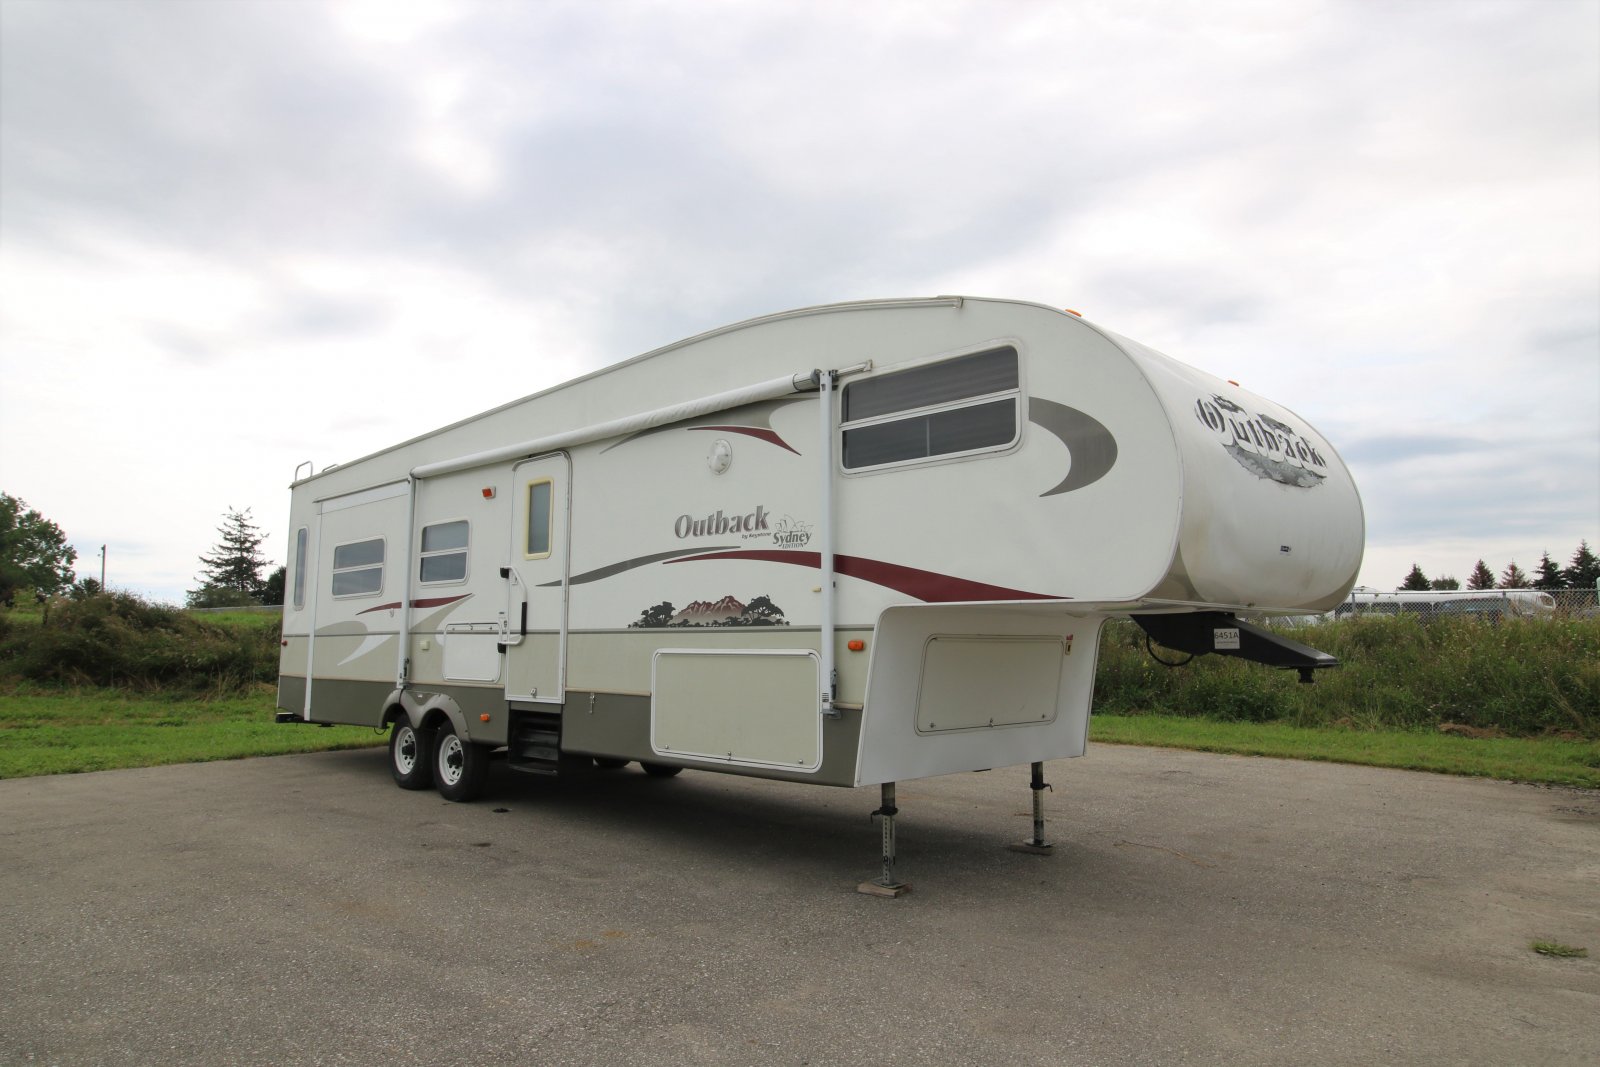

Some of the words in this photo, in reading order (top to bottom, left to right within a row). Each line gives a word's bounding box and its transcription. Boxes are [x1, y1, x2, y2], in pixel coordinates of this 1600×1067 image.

[674, 505, 770, 539] Outback
[773, 531, 812, 547] Sydney
[1215, 631, 1239, 639] 6451A
